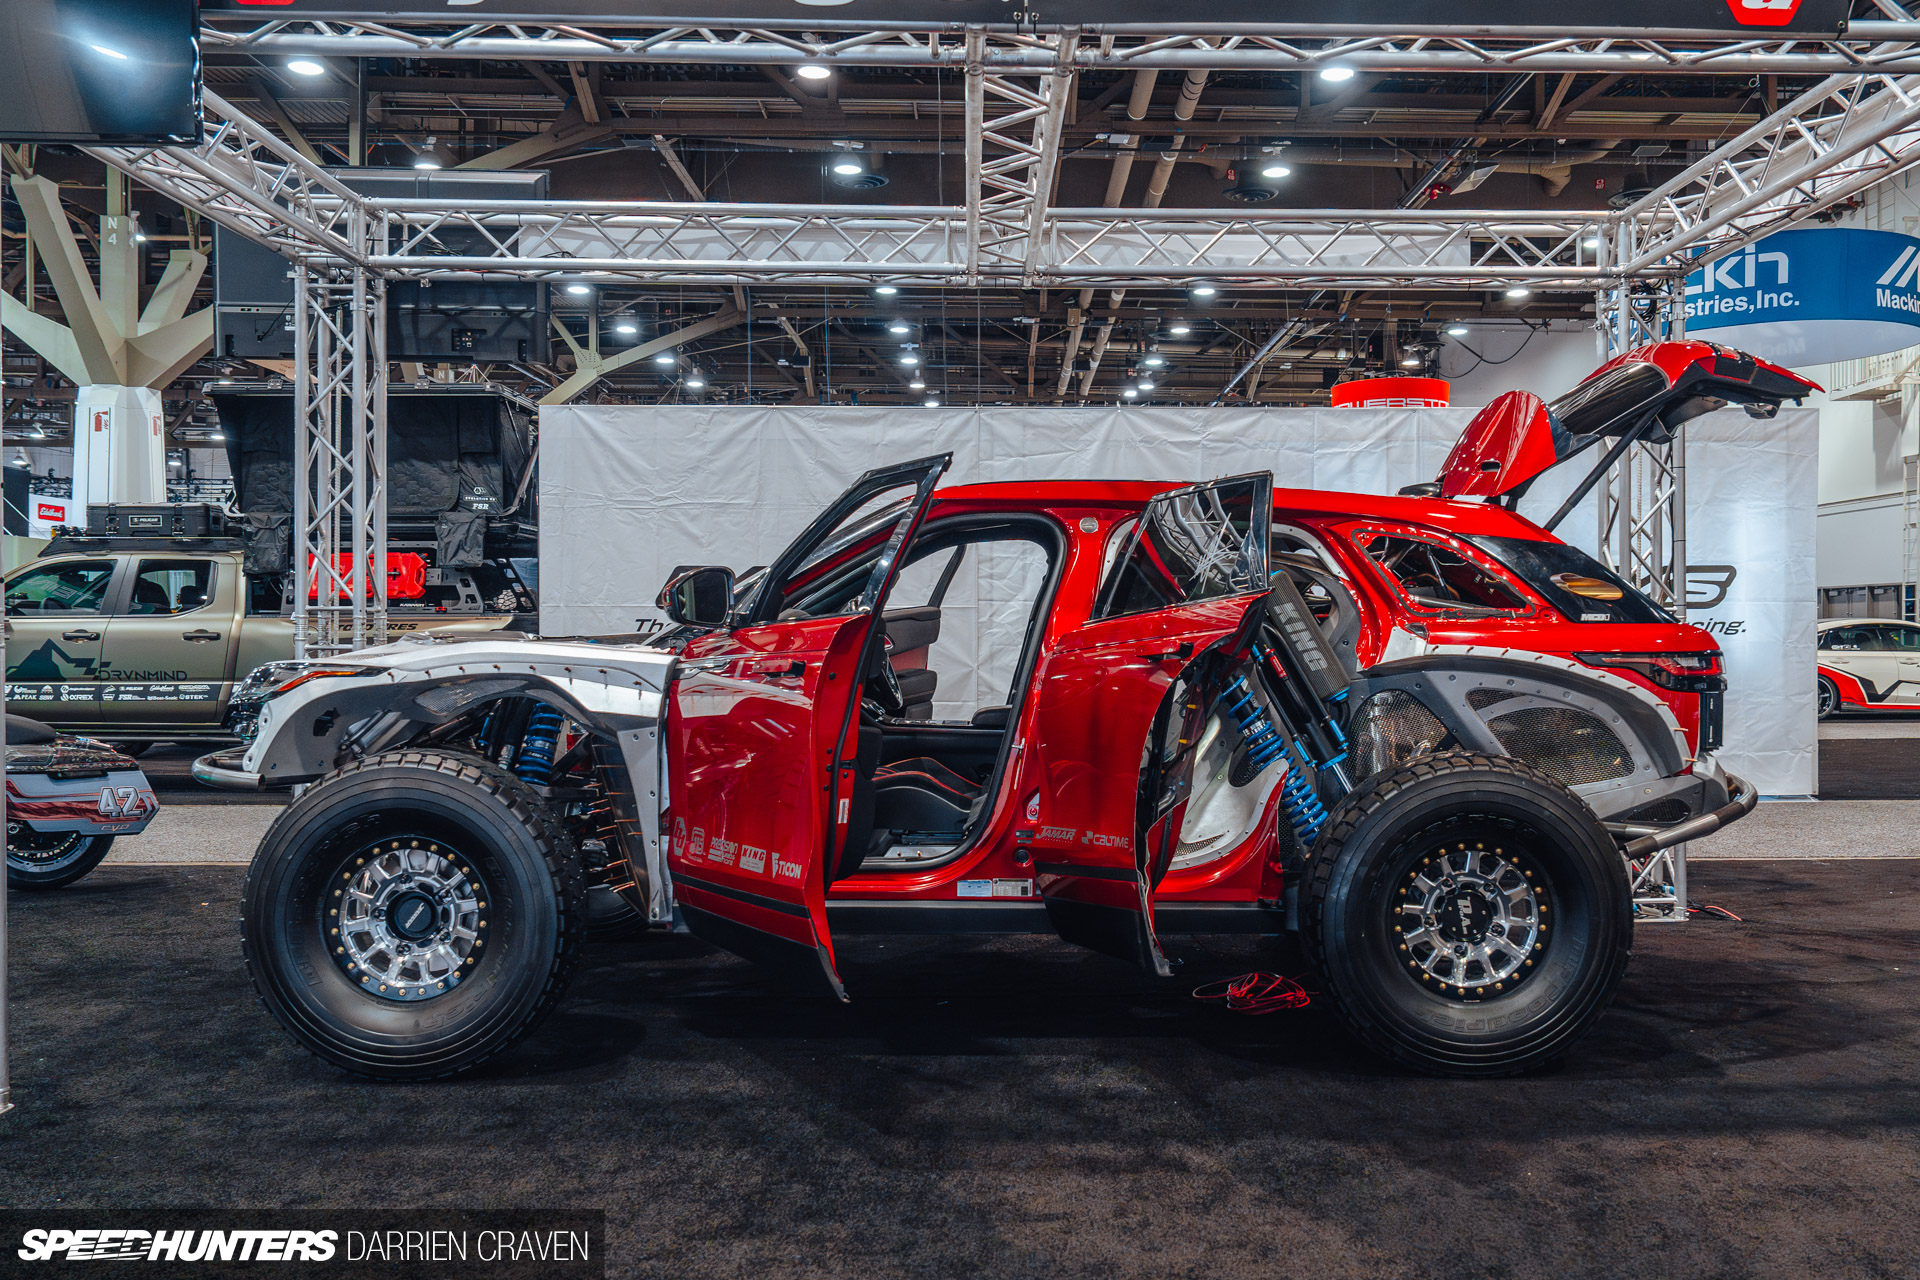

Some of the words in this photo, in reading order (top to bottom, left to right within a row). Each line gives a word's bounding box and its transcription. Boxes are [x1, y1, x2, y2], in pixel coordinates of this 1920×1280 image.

[108, 216, 118, 229] N
[108, 232, 117, 245] 4
[1684, 288, 1800, 318] stries,Inc.
[635, 618, 673, 632] Th
[1273, 602, 1328, 672] KING
[97, 786, 144, 818] 42
[1036, 825, 1077, 841] JAMAR
[742, 847, 766, 861] KING
